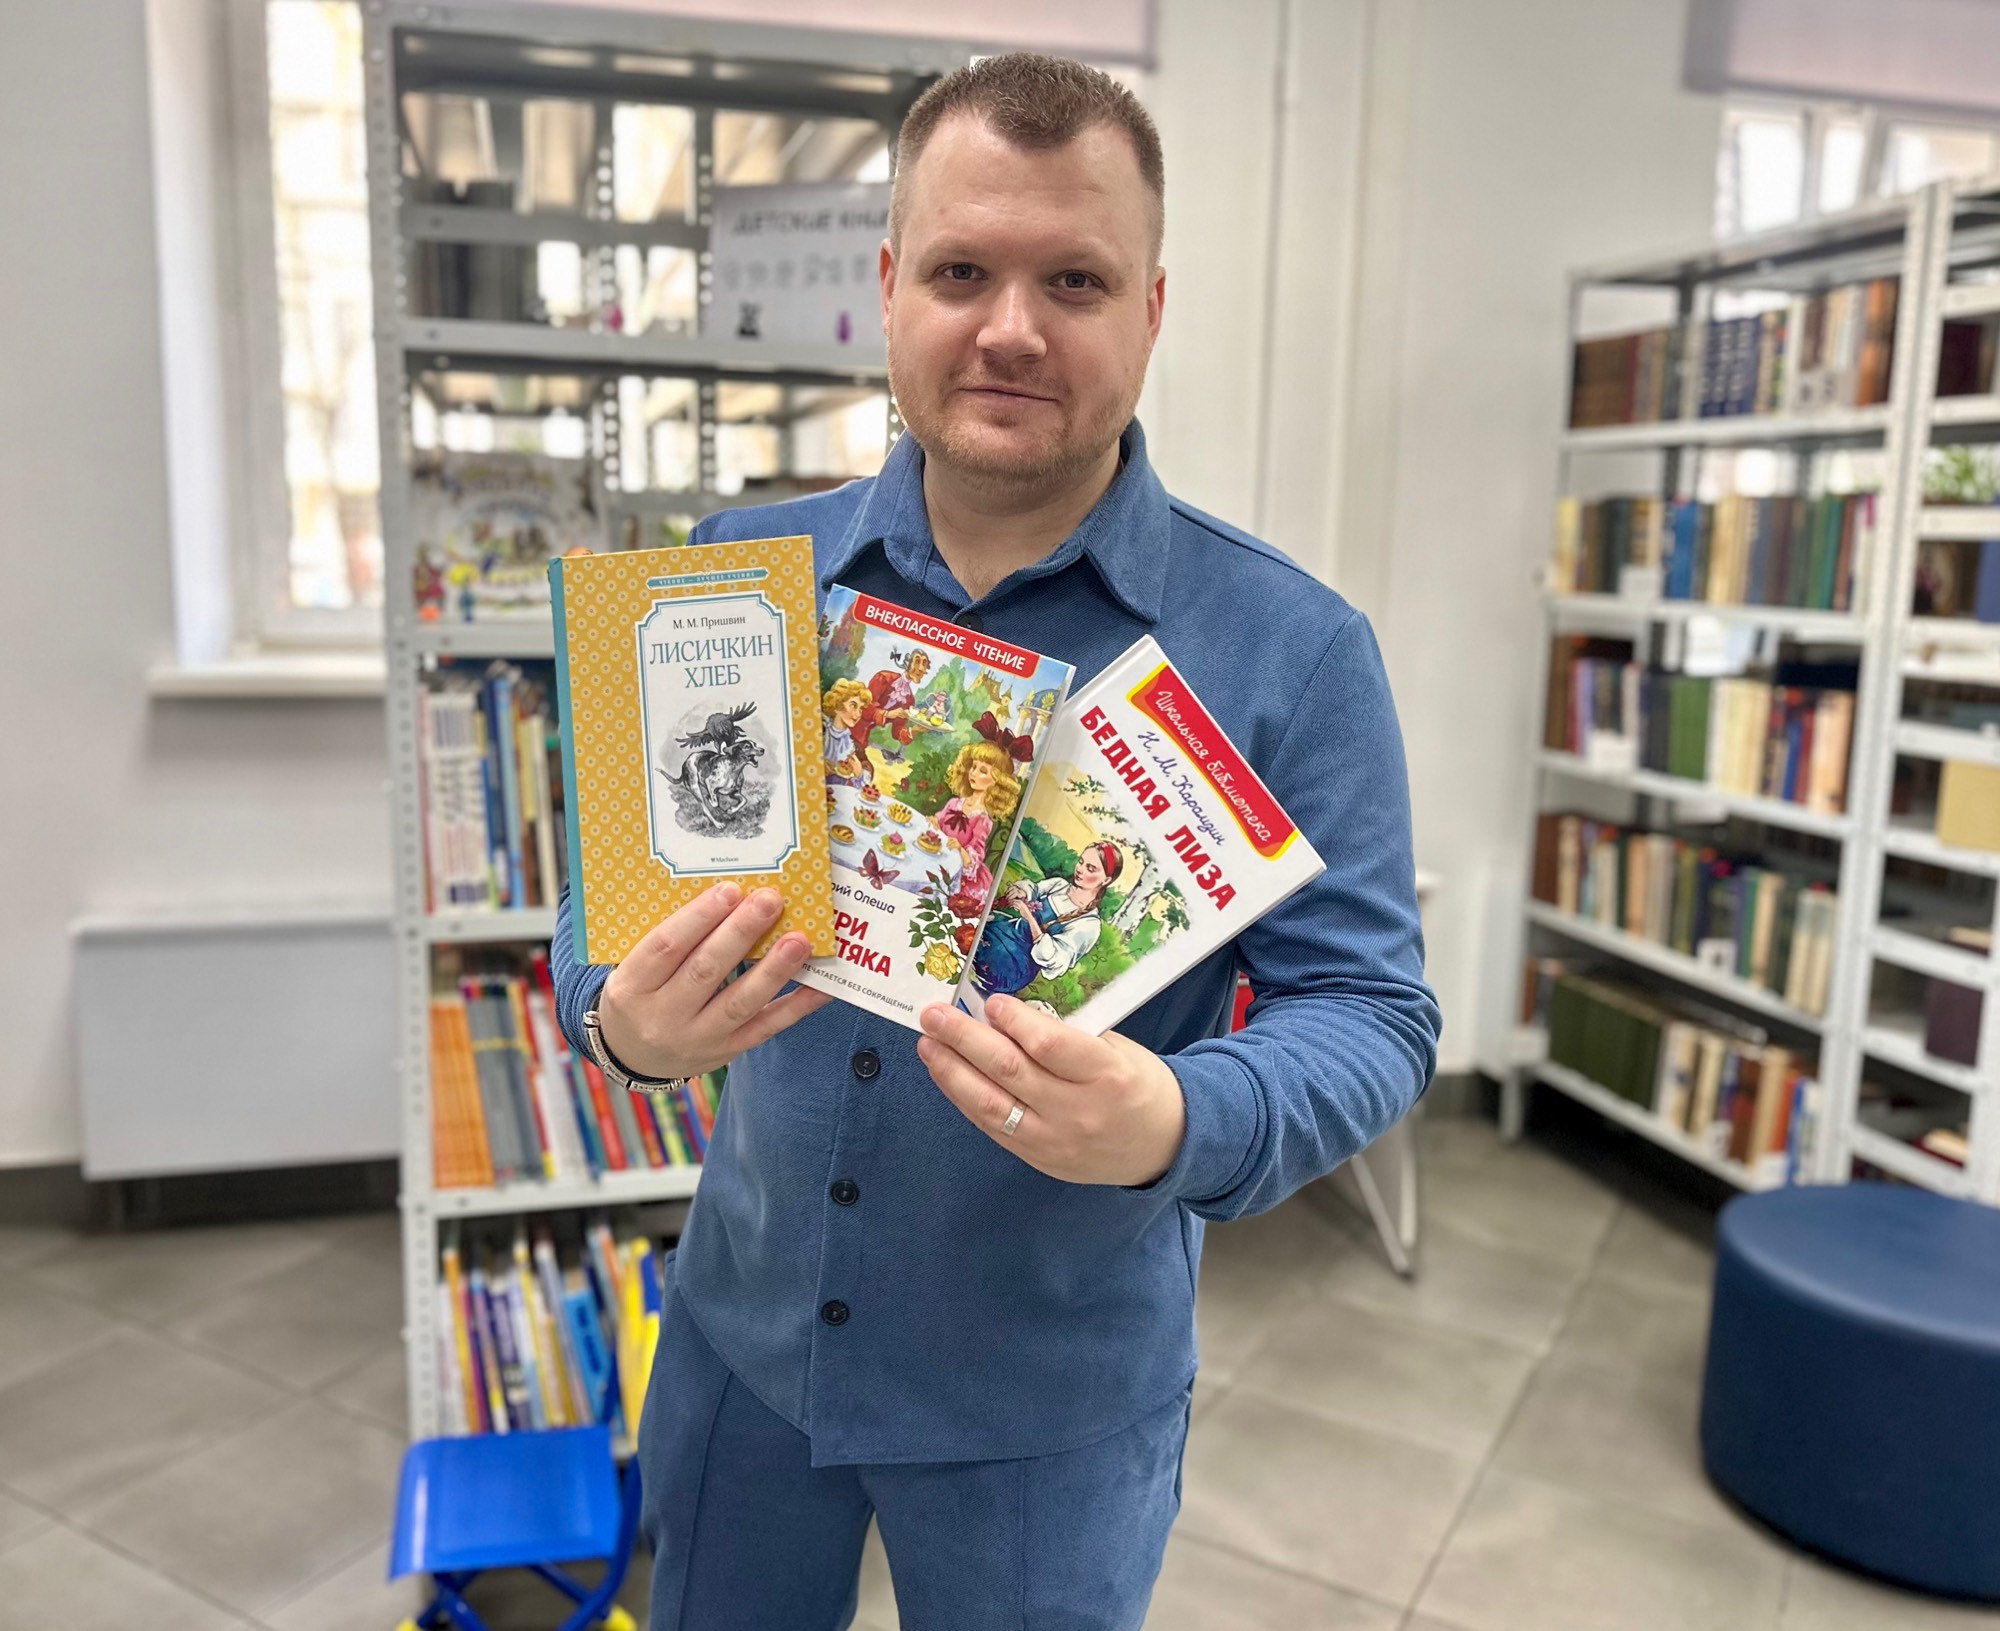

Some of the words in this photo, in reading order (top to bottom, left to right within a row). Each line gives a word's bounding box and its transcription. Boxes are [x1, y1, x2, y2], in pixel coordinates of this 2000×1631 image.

[673, 619, 685, 630] М.
[687, 618, 699, 629] М.
[701, 616, 746, 630] Пришвин
[865, 604, 966, 650] ВНЕКЛАССНОЕ
[973, 641, 1026, 670] ЧТЕНИЕ
[649, 634, 774, 664] ЛИСИЧКИН
[684, 664, 741, 688] ХЛЕБ
[1156, 690, 1209, 760] Школьная
[1206, 760, 1272, 842] библиотека
[1079, 705, 1172, 821] БЕДНАЯ
[1164, 825, 1237, 912] ЛИЗА
[1137, 731, 1160, 752] Н.
[1152, 756, 1178, 777] М.
[1171, 774, 1226, 846] Карамзин
[854, 889, 896, 914] Олеша
[833, 908, 869, 941] РИ
[835, 935, 891, 977] ТЯКА
[801, 963, 847, 986] ПЕЧАТАЕТСЯ
[847, 981, 861, 992] БЕЗ
[861, 987, 914, 1013] СОКРАЩЕНИЙ
